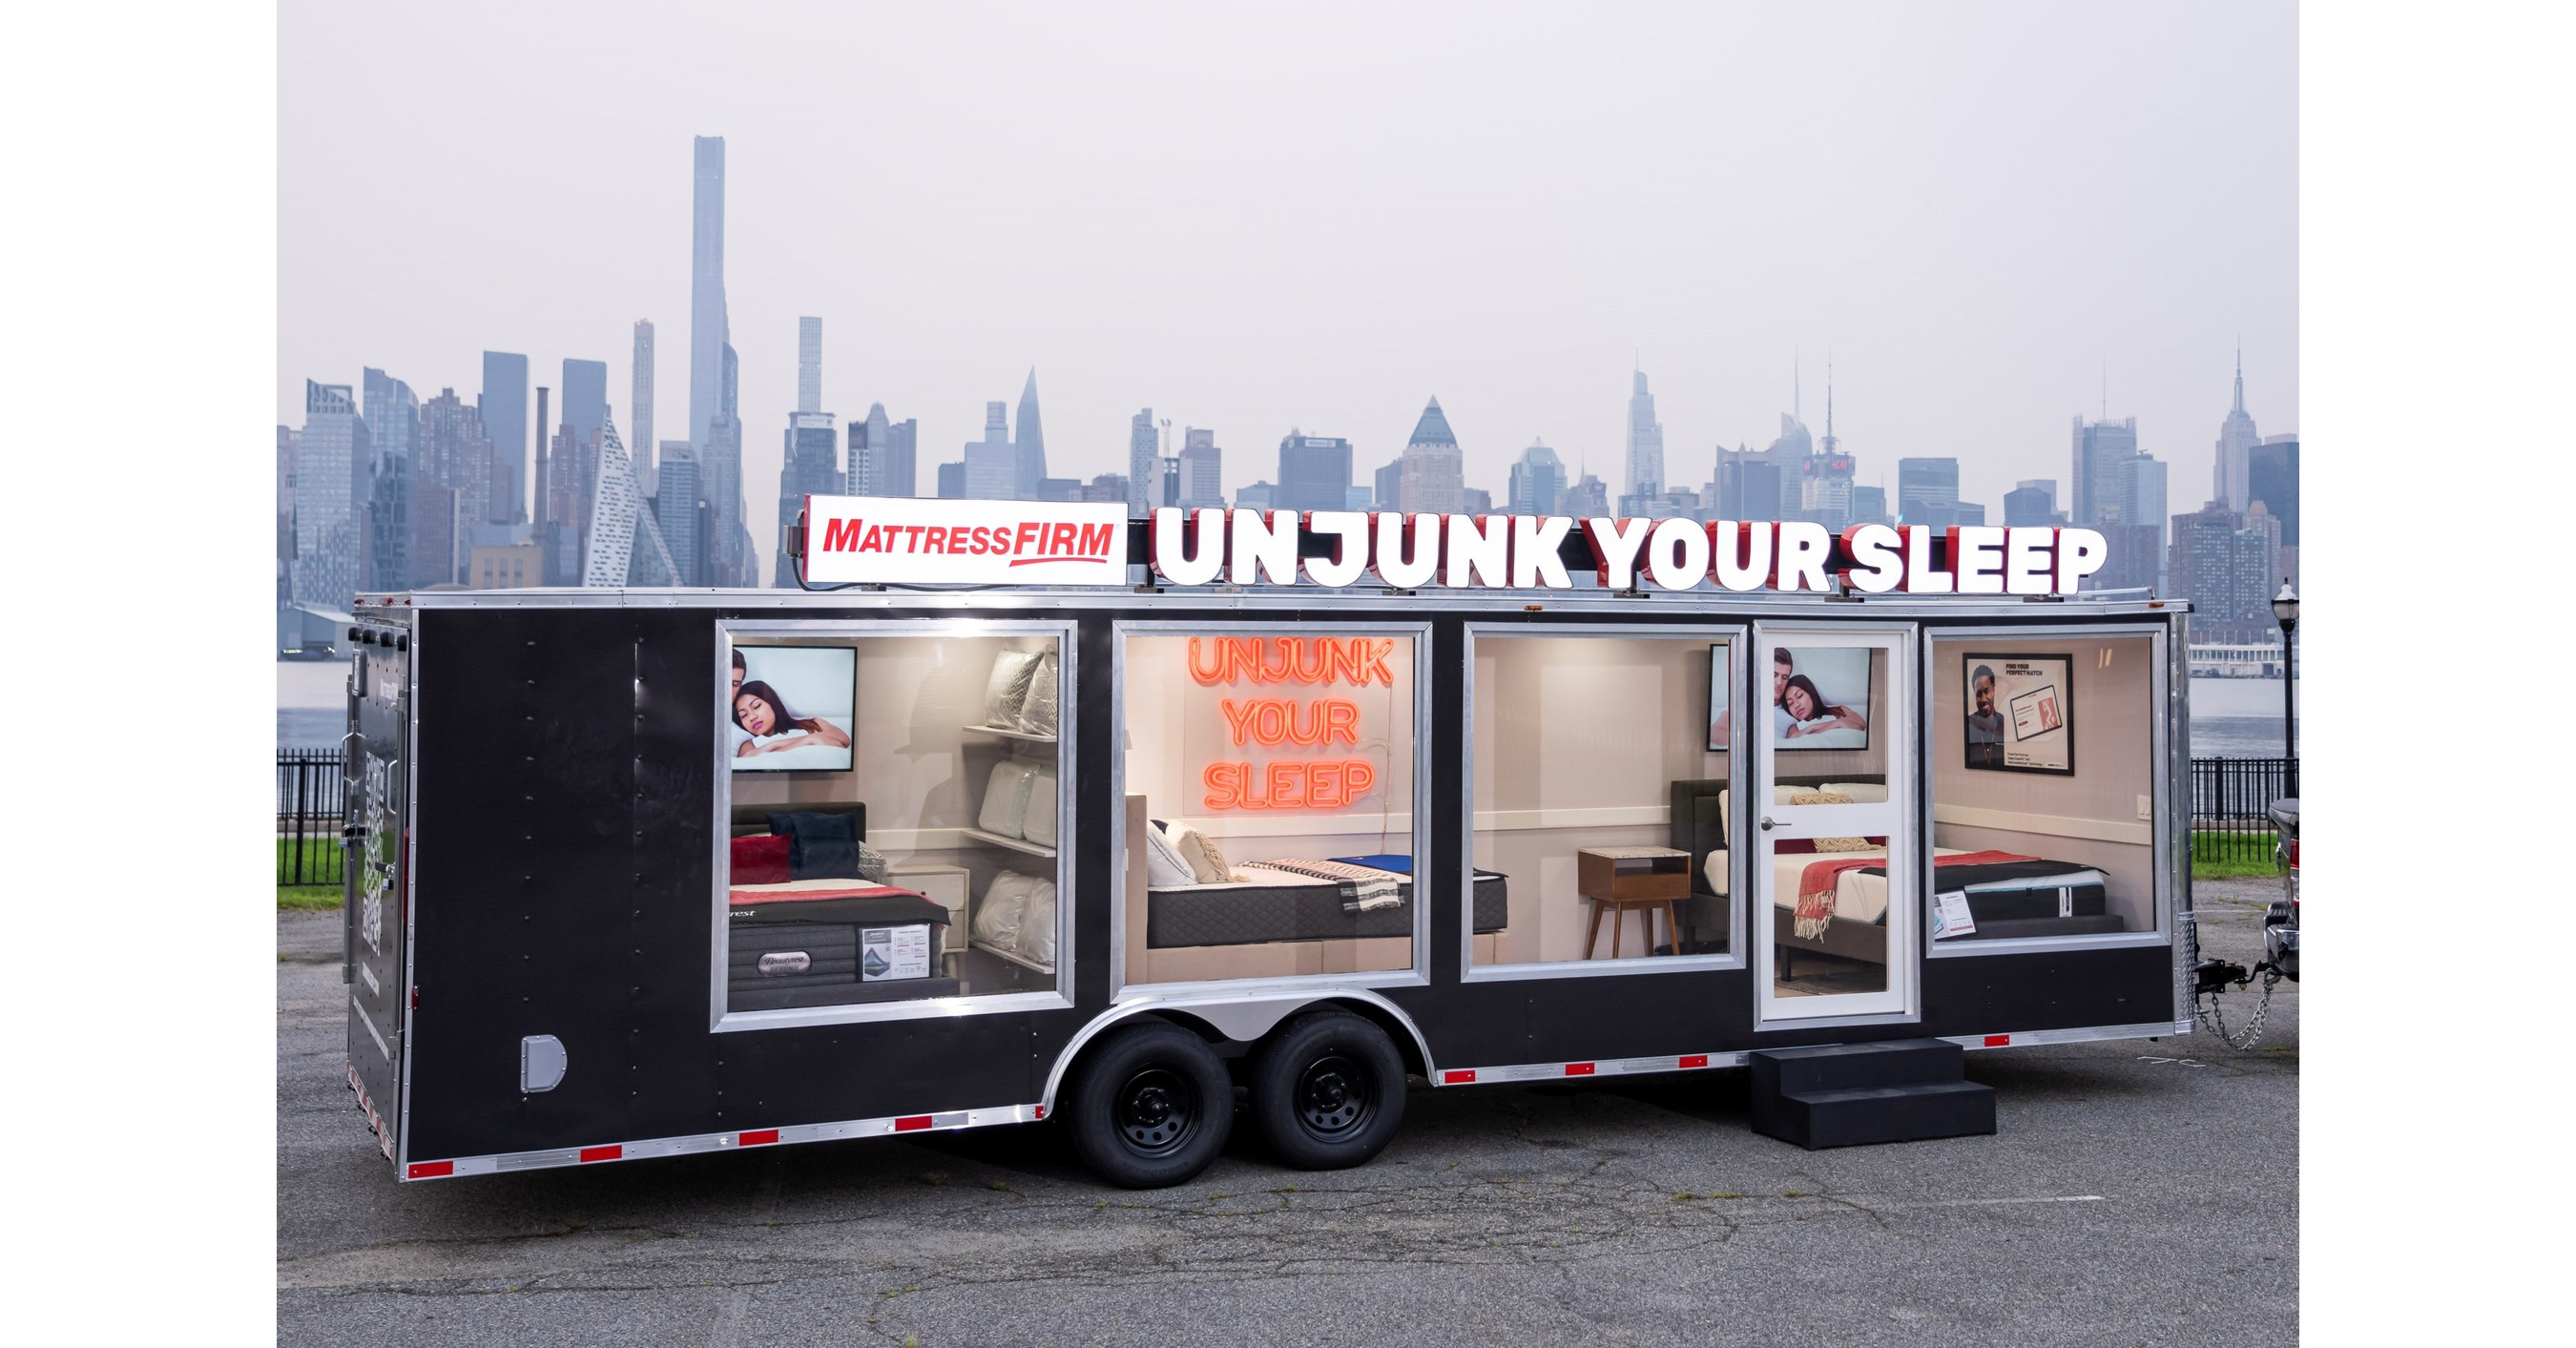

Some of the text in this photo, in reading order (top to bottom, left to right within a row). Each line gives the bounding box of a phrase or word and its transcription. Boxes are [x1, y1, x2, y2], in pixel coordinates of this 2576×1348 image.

[1155, 508, 2108, 594] UNJUNK YOUR SLEEP
[1189, 636, 1394, 683] UNJUNK
[1222, 699, 1360, 746] YOUR
[1204, 760, 1374, 809] SLEEP
